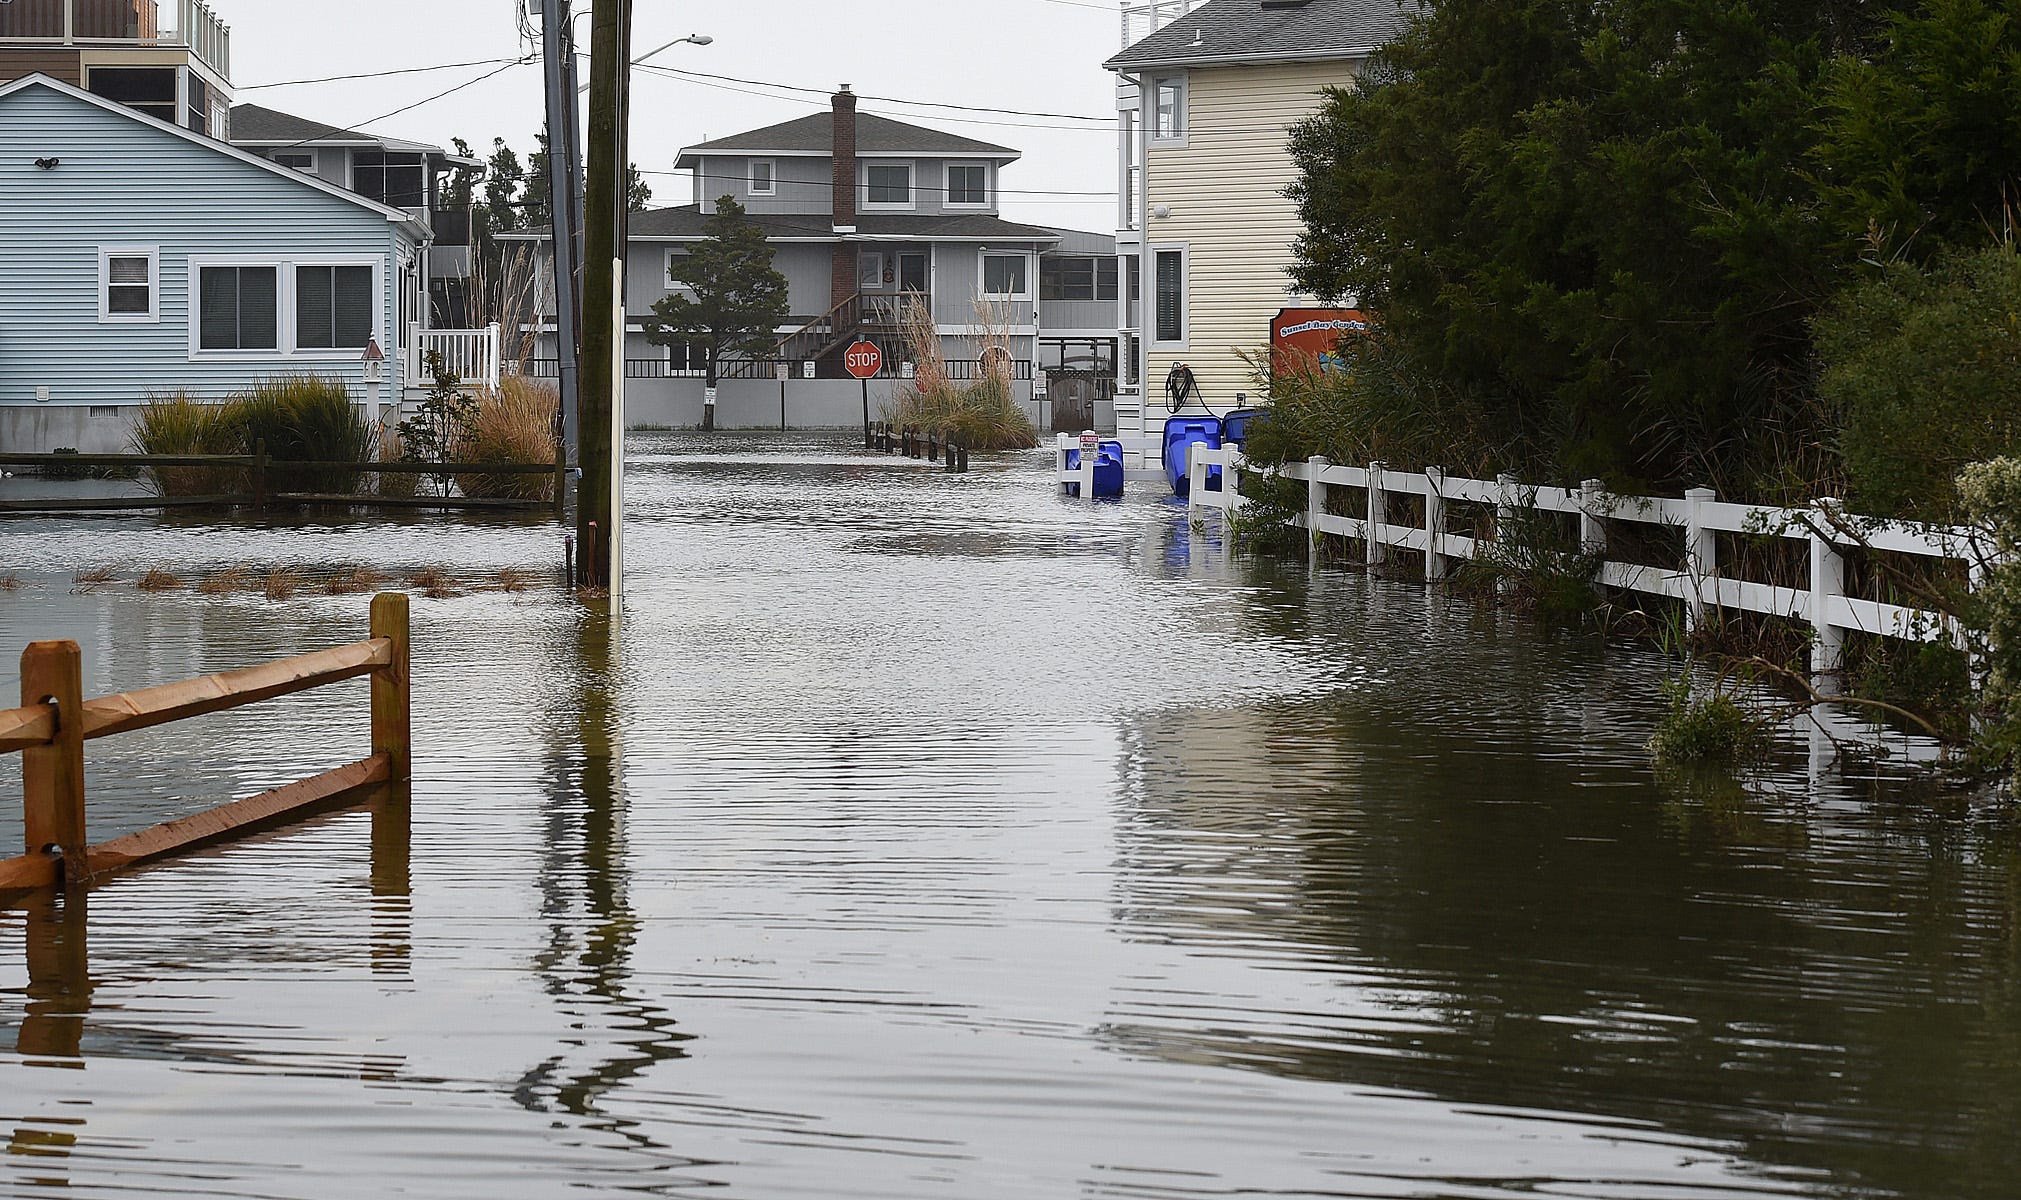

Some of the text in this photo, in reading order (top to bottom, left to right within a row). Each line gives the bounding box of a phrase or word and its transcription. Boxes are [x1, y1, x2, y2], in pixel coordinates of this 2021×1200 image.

[1281, 321, 1312, 337] Sunset
[1312, 320, 1331, 329] Bay
[848, 353, 878, 367] STOP
